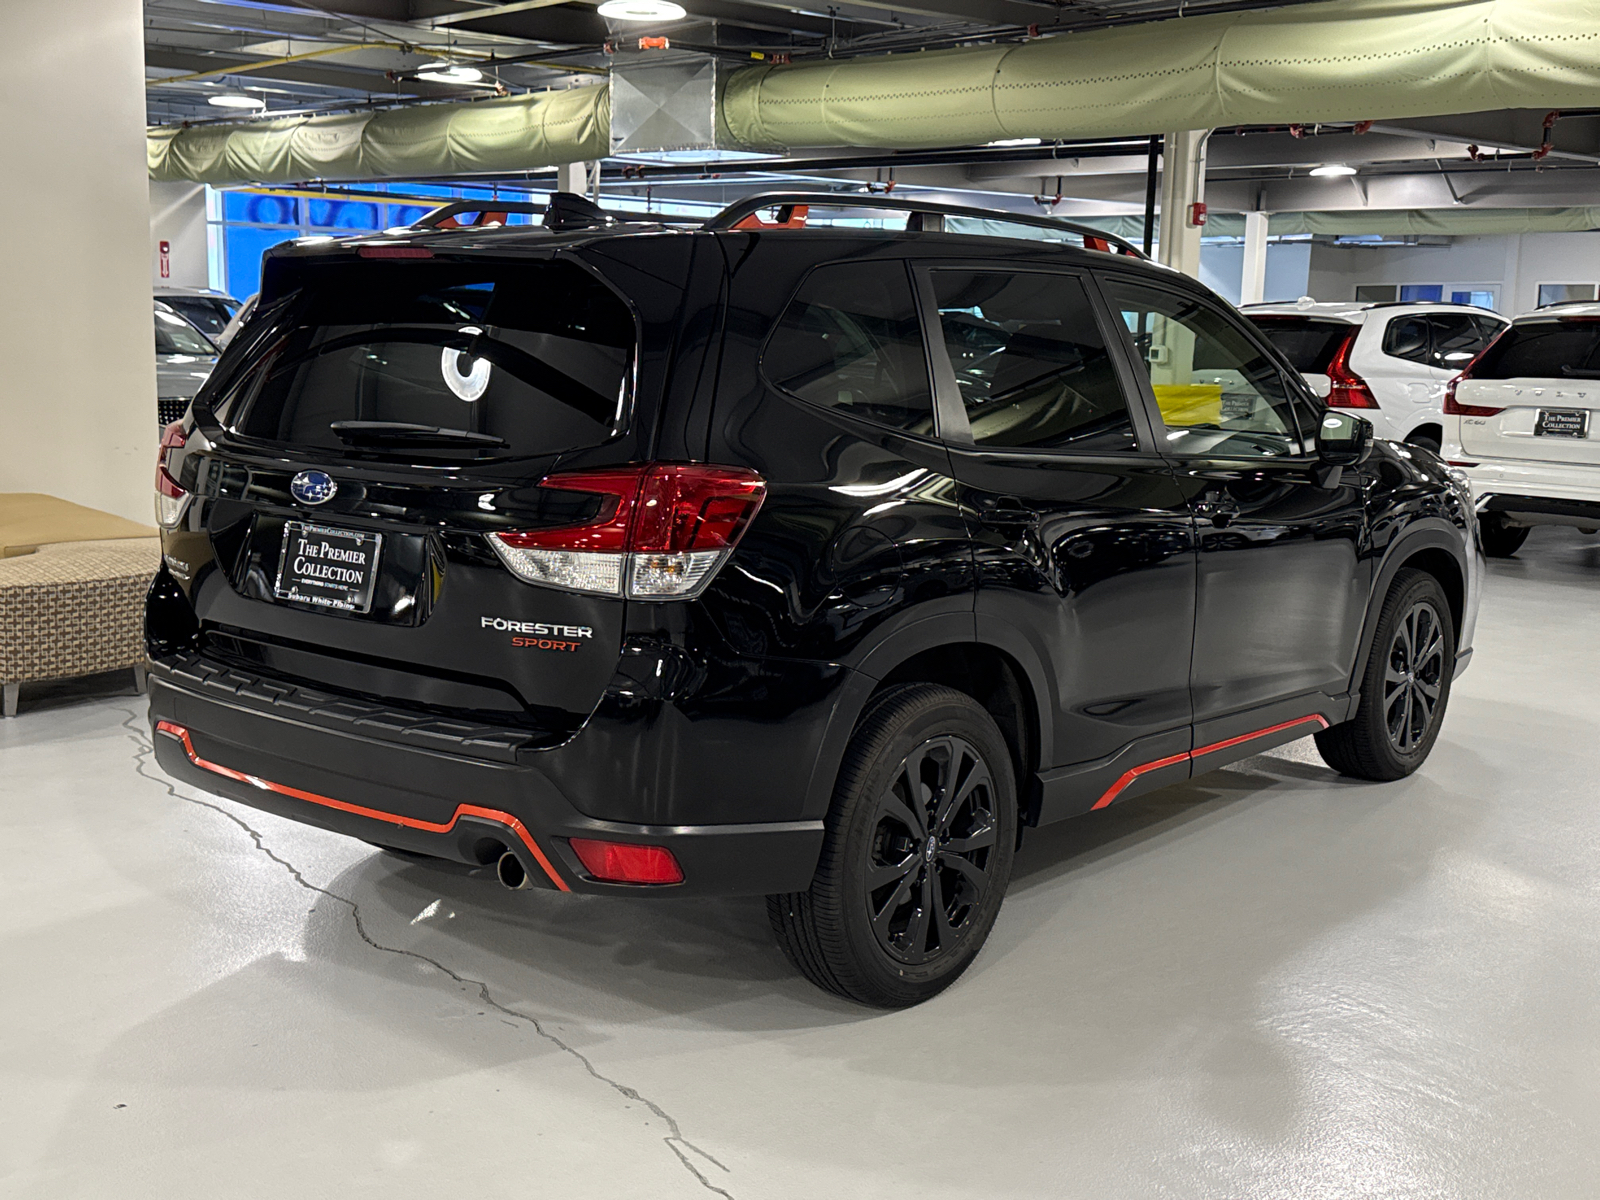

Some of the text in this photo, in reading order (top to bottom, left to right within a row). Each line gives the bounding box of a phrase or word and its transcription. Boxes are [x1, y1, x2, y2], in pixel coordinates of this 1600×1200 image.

[297, 538, 366, 565] THE PREMIER
[293, 556, 364, 584] COLLECTION
[481, 616, 593, 638] FORESTER
[511, 636, 581, 652] SPORT
